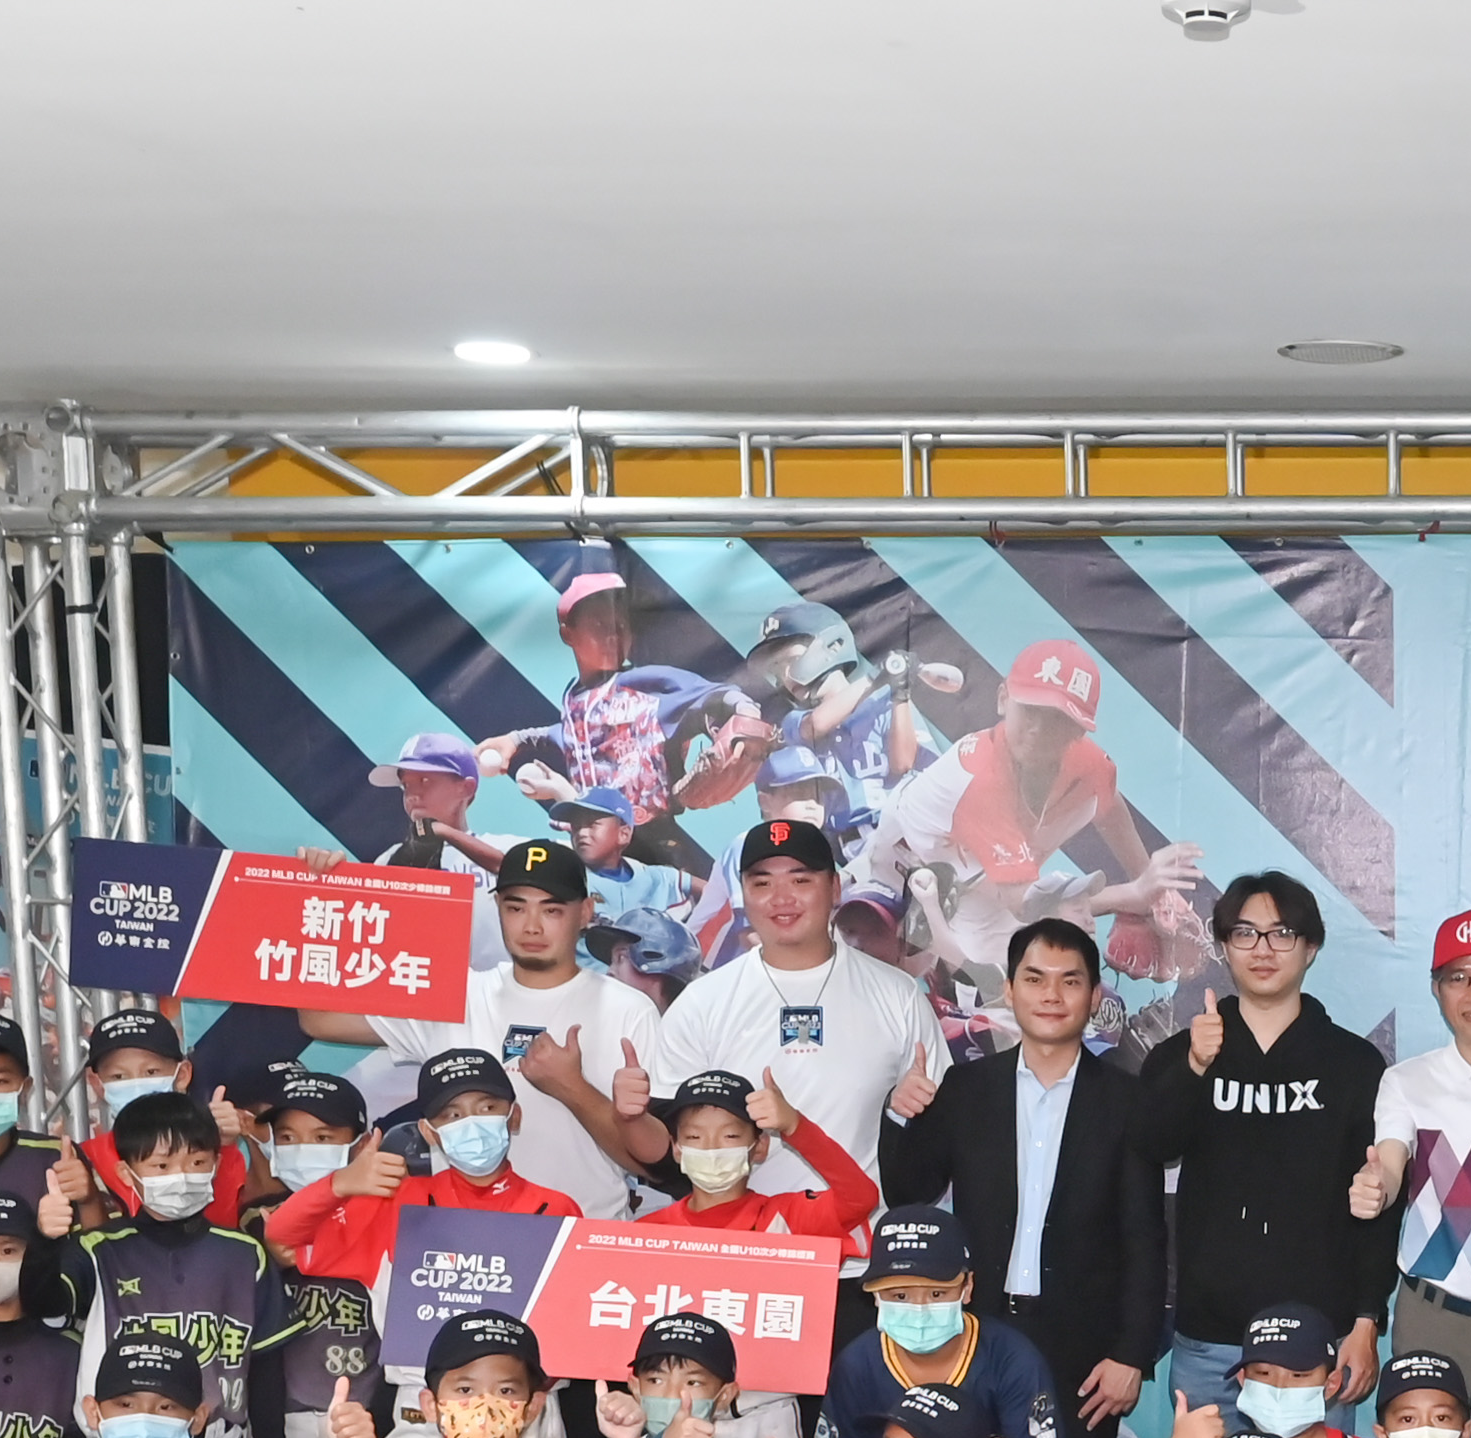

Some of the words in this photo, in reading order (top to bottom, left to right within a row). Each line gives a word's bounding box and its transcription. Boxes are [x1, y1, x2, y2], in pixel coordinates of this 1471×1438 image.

[301, 896, 391, 944] 新竹
[254, 937, 432, 995] 竹風少年
[588, 1280, 805, 1342] 台北東園
